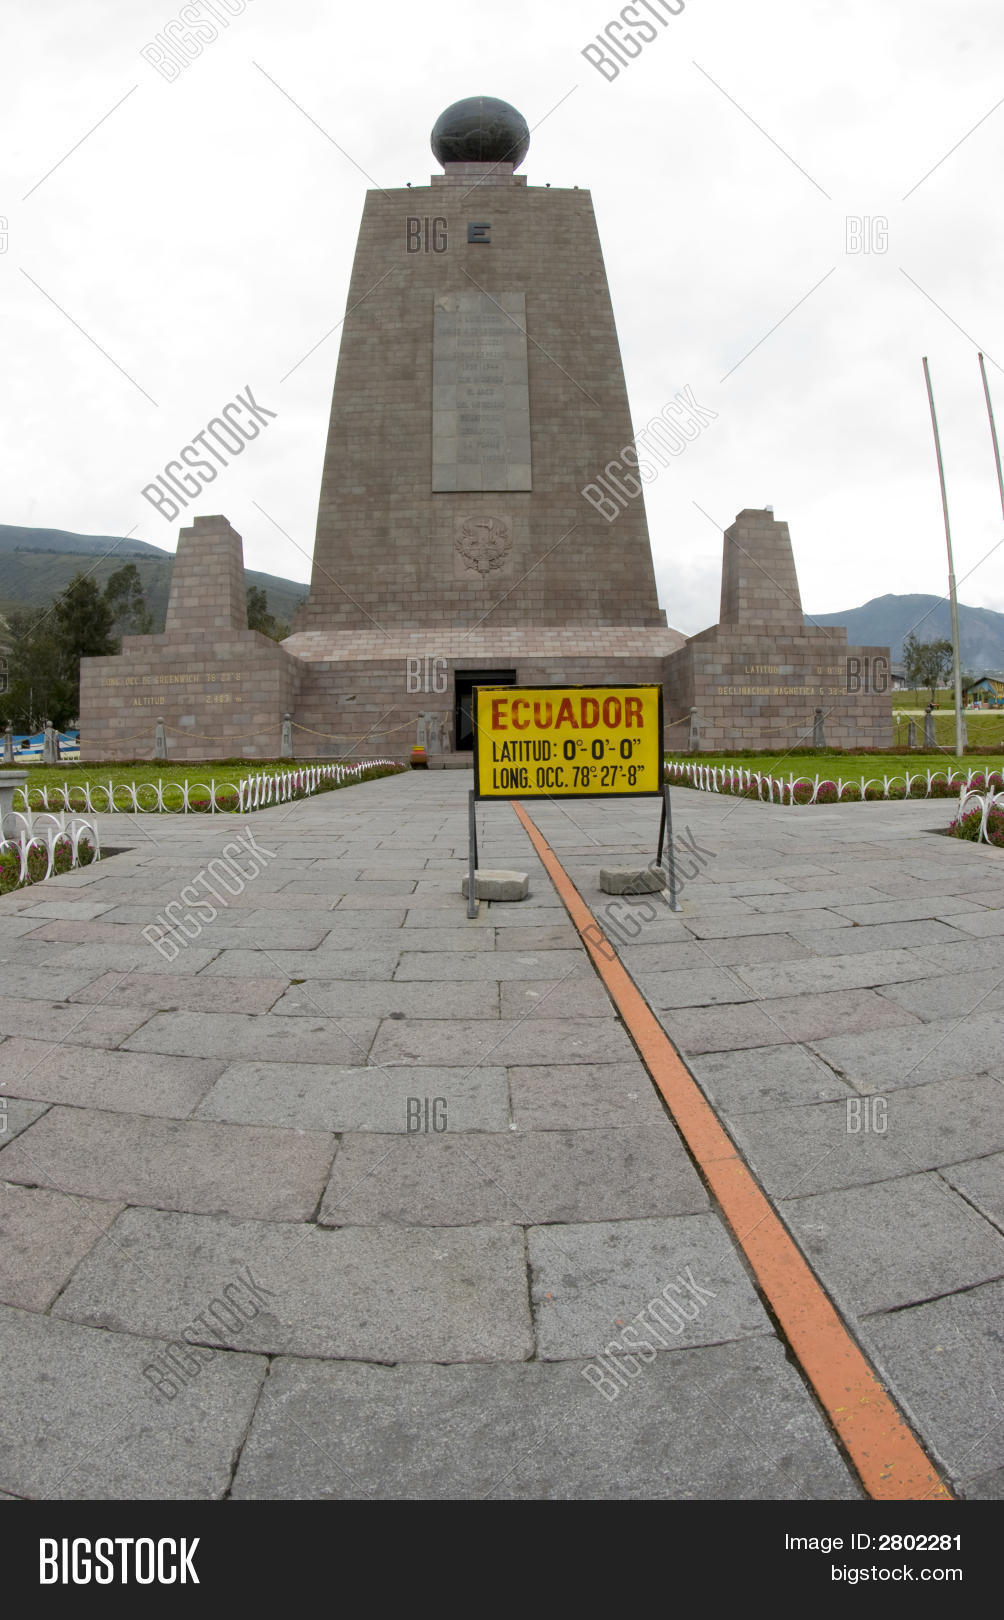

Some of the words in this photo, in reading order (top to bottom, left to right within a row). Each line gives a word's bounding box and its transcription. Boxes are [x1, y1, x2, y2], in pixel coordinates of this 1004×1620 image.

[467, 221, 492, 244] E
[491, 695, 644, 731] ECUADOR
[492, 740, 558, 762] LATITUD:
[492, 767, 533, 789] LONG.
[536, 766, 569, 788] OCC.
